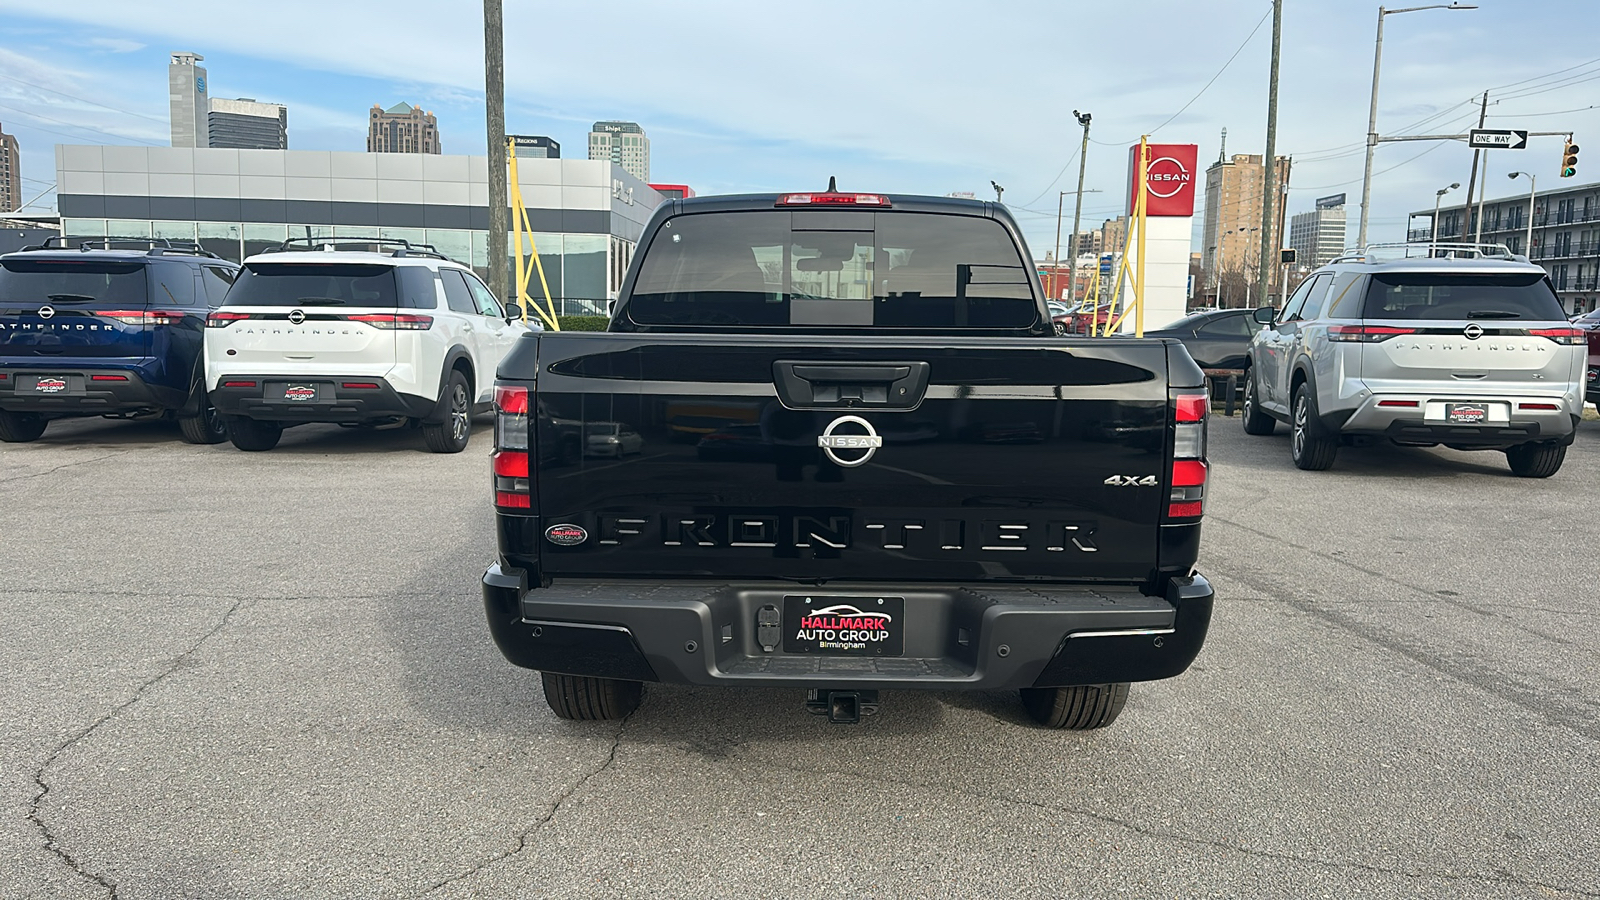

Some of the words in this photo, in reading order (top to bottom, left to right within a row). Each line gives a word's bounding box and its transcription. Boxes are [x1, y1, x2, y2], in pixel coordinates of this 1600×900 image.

[1396, 343, 1546, 351] PATHFINDER
[819, 438, 880, 446] NISSAN
[597, 515, 1098, 552] FRONTIER
[801, 617, 885, 630] HALLMARK
[796, 629, 836, 641] AUTO
[839, 630, 889, 642] GROUP
[819, 642, 866, 650] Birmingham
